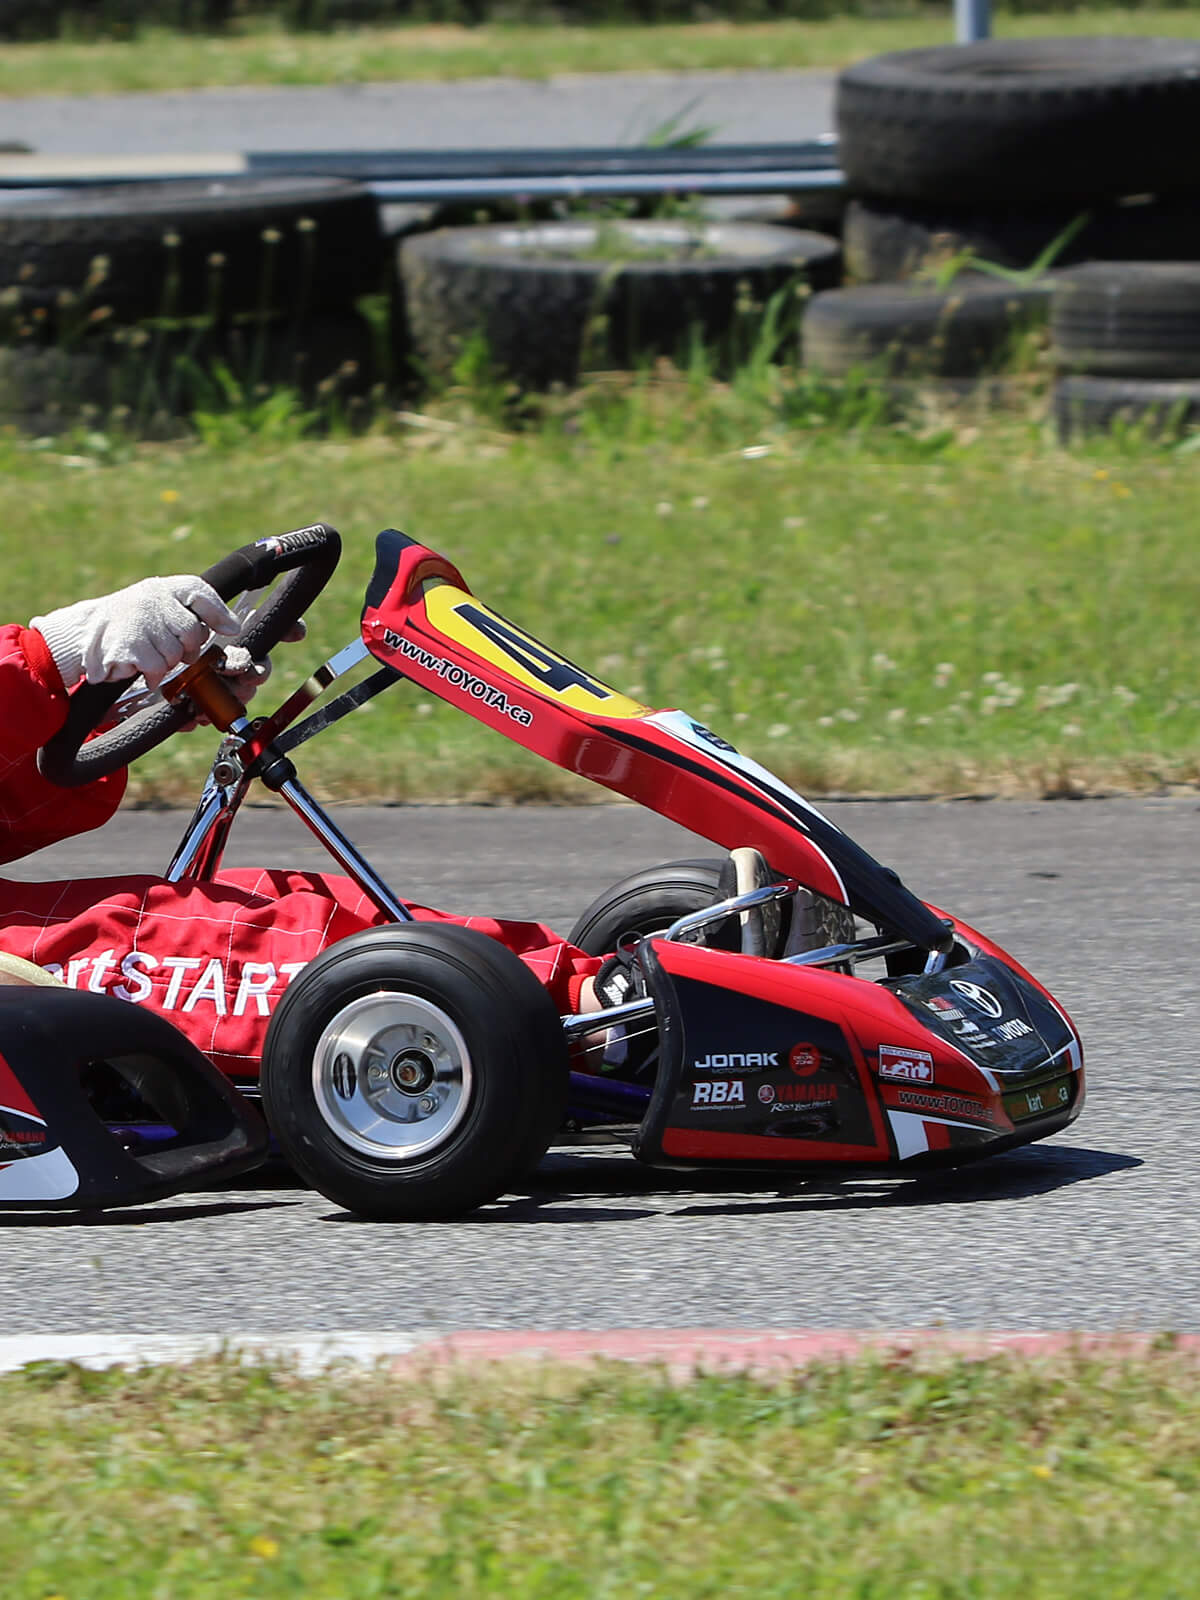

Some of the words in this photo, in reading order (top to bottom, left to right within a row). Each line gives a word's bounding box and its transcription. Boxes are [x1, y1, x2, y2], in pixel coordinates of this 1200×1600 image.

[383, 627, 534, 728] www.TOYOTA.ca
[41, 949, 308, 1017] artSTART
[694, 1053, 779, 1068] JONAK
[692, 1080, 745, 1104] RBA
